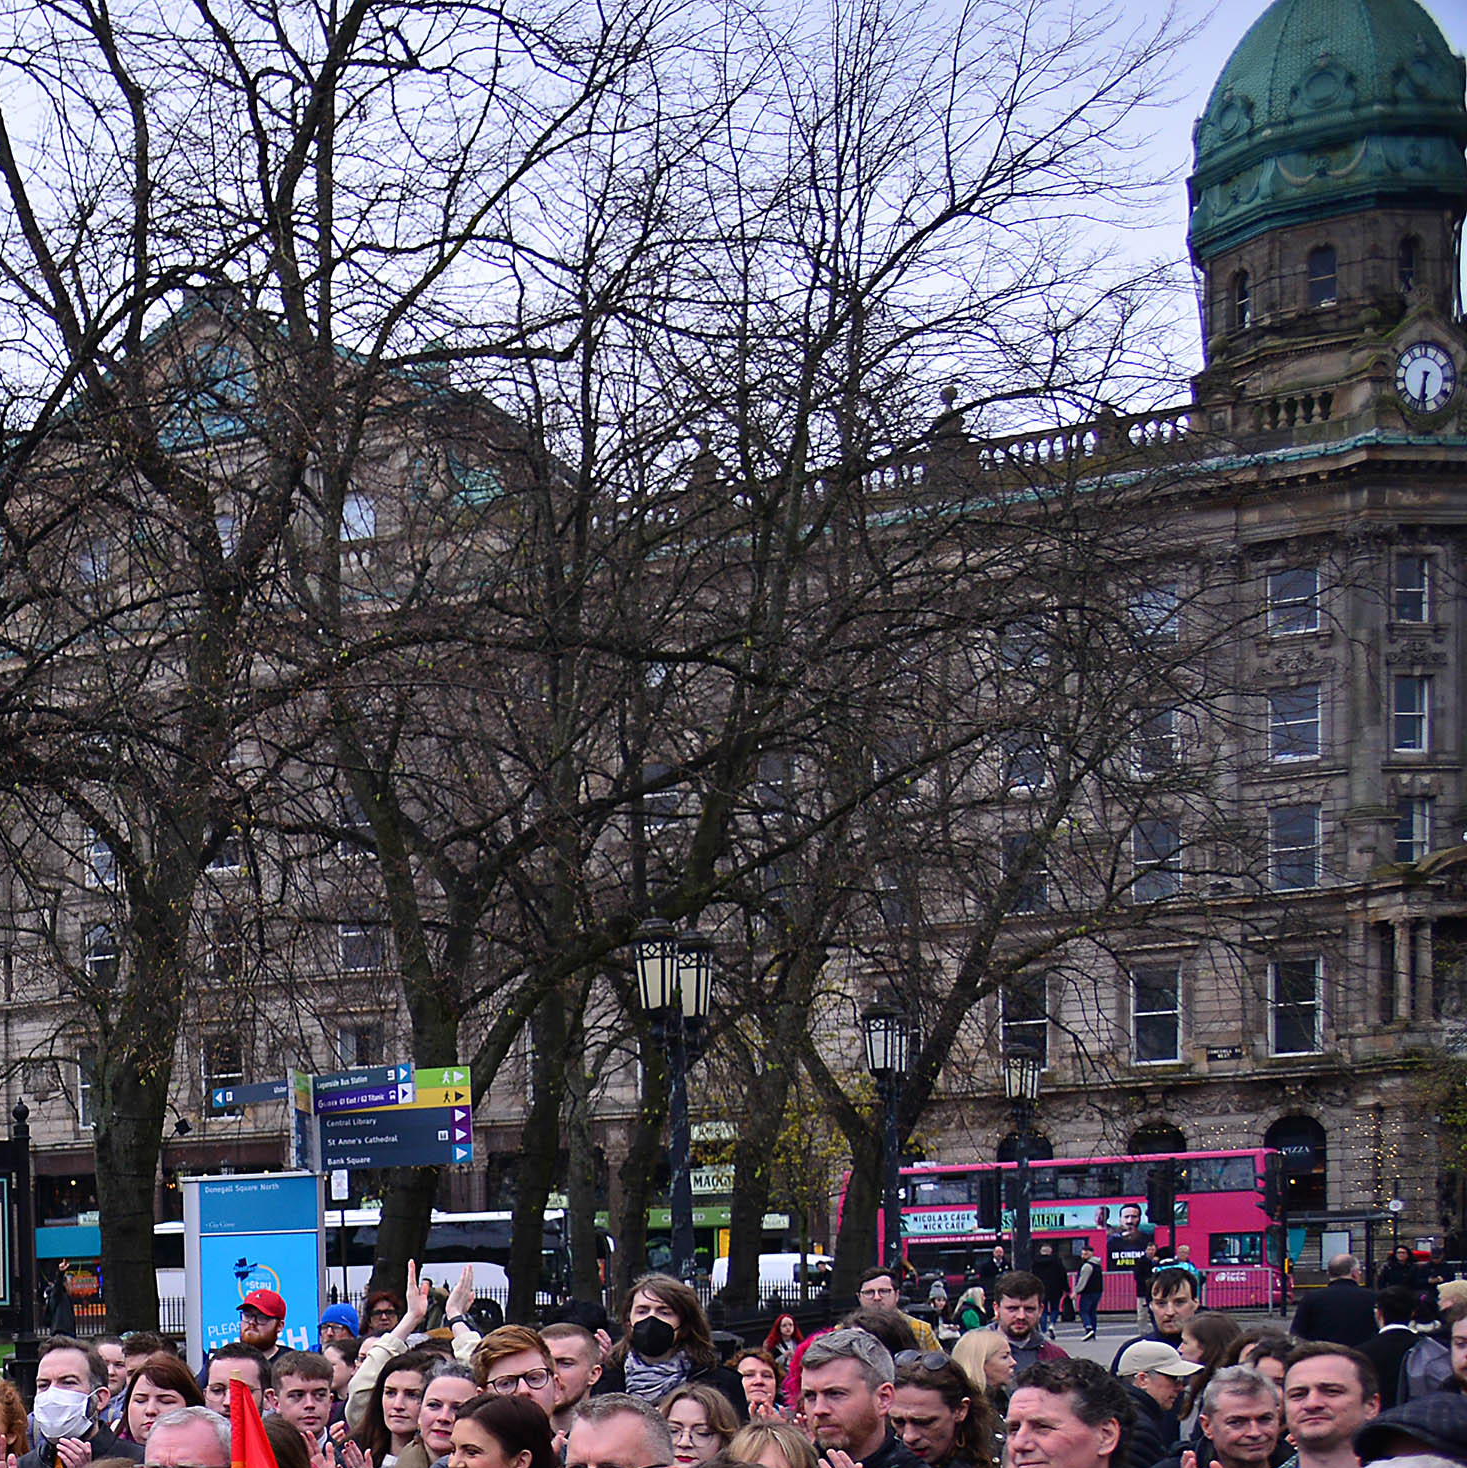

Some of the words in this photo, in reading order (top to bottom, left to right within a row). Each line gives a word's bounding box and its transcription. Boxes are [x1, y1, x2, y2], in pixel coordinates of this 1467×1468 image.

[340, 1078, 350, 1086] Bus
[350, 1075, 368, 1085] Station
[367, 1093, 384, 1102] Titanic
[326, 1117, 352, 1127] Central
[354, 1116, 377, 1127] Library
[327, 1138, 336, 1146] St
[337, 1136, 362, 1145] Anne's
[364, 1134, 398, 1144] Cathedral
[327, 1157, 344, 1165] Bank
[345, 1155, 371, 1166] Square
[204, 1185, 234, 1195] Donegall
[235, 1184, 258, 1194] Square
[260, 1182, 280, 1191] North
[913, 1213, 948, 1222] NICOLAS
[950, 1213, 970, 1222] CAGE
[923, 1222, 944, 1230] NICK
[945, 1222, 965, 1230] CAGE
